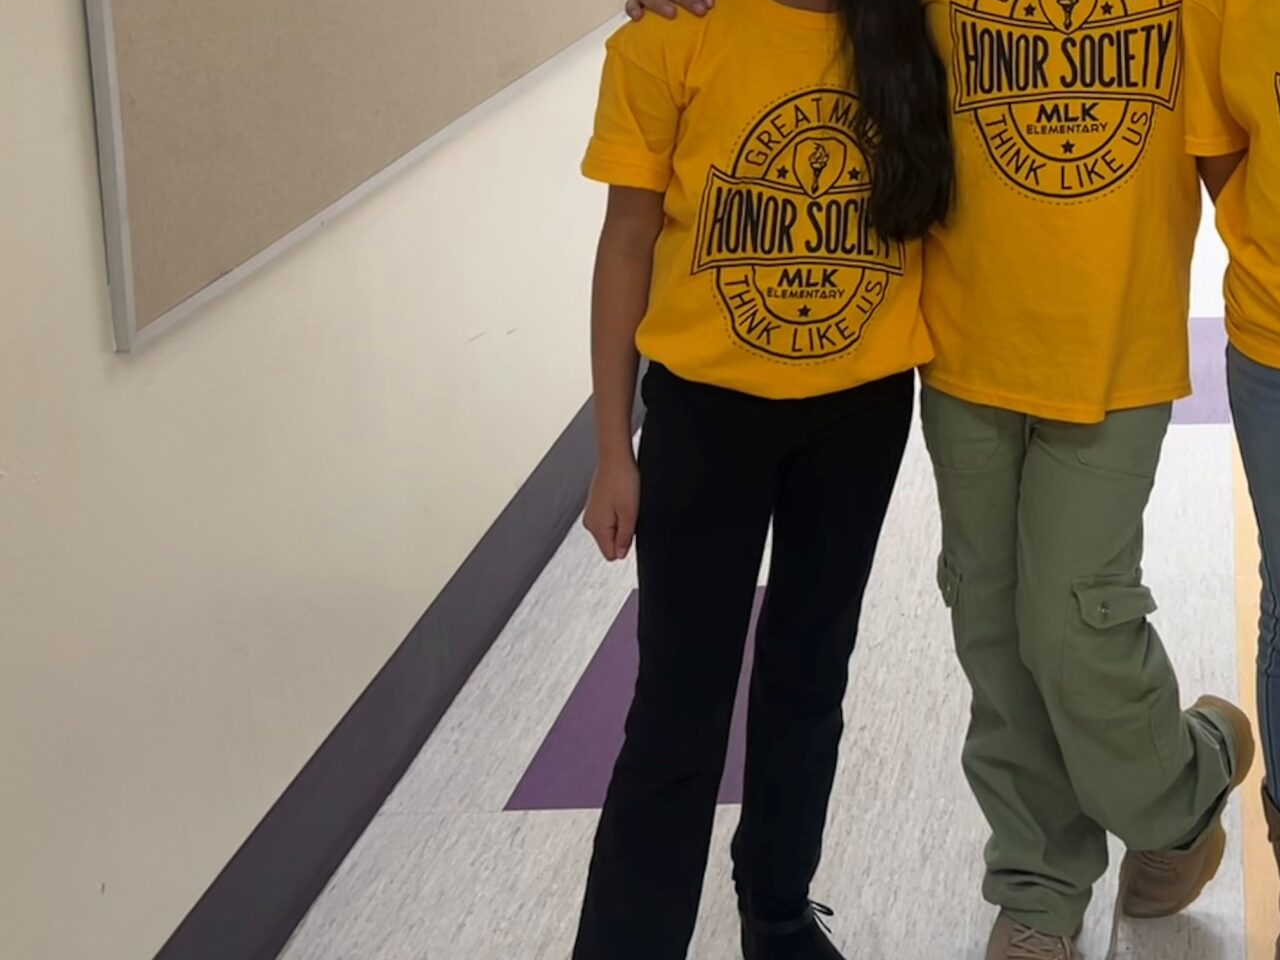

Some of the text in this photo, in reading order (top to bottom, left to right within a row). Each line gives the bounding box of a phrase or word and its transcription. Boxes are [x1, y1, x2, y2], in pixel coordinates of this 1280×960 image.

[962, 20, 1173, 97] HONOR SOCIETY
[745, 97, 824, 167] GREAT
[1026, 122, 1108, 136] ELEMENTARY
[1036, 102, 1100, 124] MLK
[985, 110, 1150, 190] THINK LIKE US
[707, 186, 890, 259] HONOR SOCIE
[766, 287, 846, 300] ELEMENTARY
[777, 268, 840, 288] MLK
[724, 274, 883, 353] THINK LIKE US
